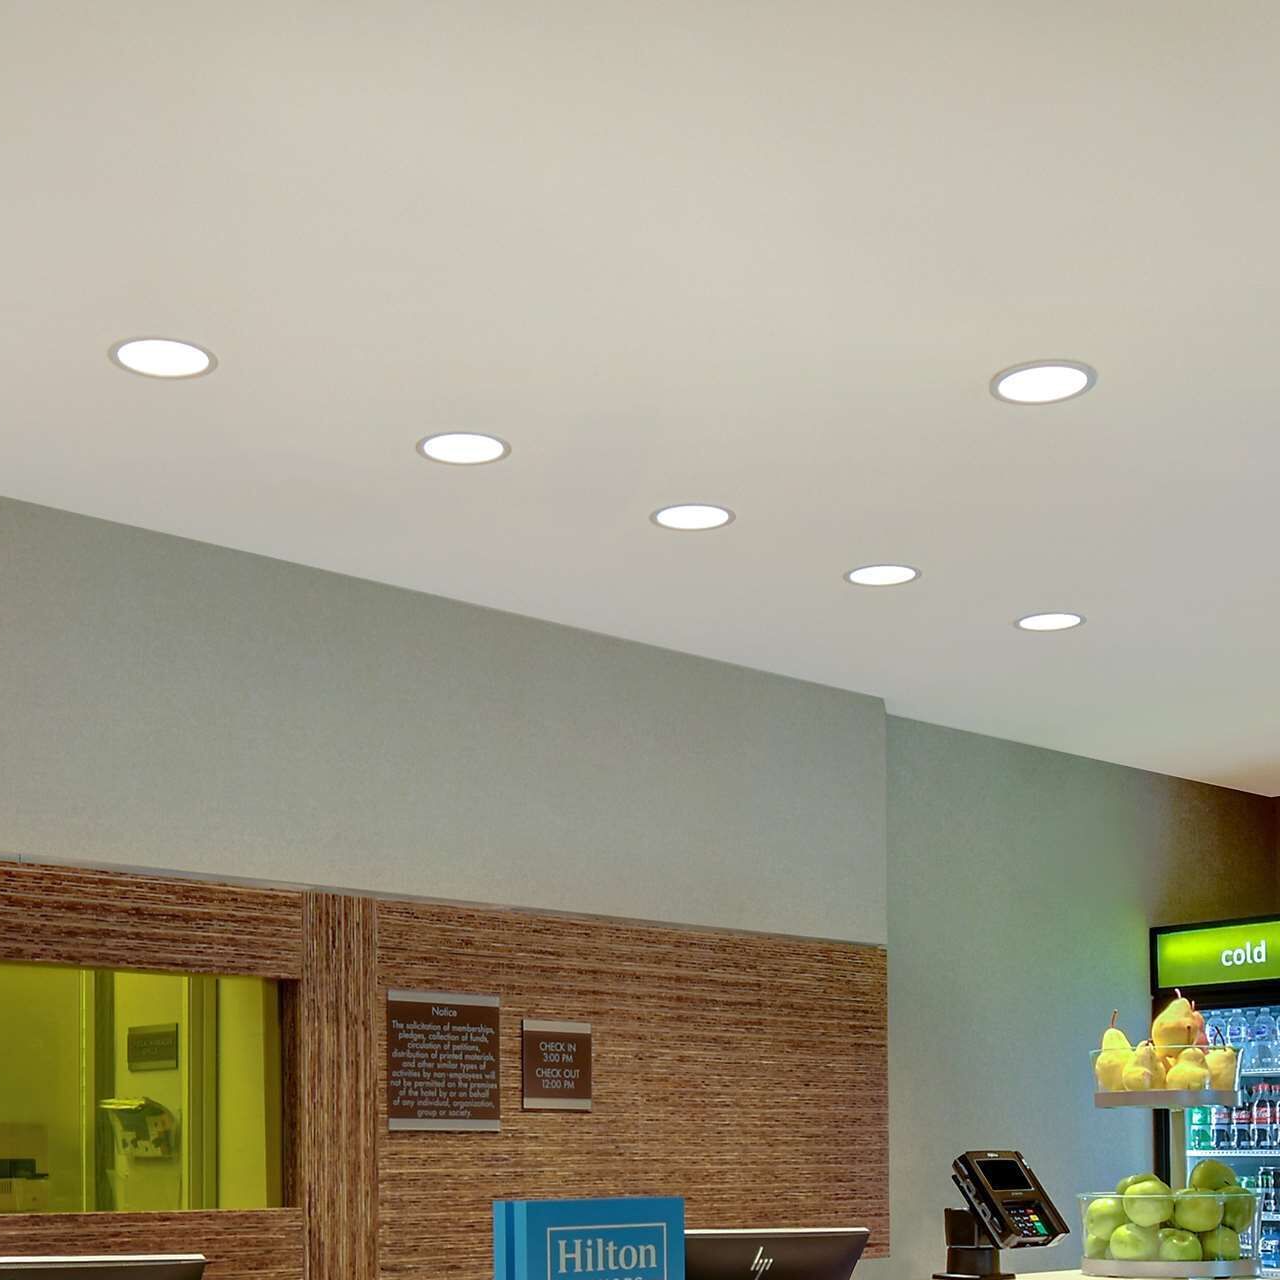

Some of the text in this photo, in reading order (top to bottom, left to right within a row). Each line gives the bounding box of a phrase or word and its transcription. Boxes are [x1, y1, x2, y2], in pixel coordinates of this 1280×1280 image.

[1220, 940, 1267, 967] cold
[431, 1006, 458, 1017] Notice
[539, 1041, 577, 1053] CHECK IN
[543, 1052, 574, 1063] 3:00 PM
[536, 1067, 580, 1079] CHECK OUT
[563, 1079, 575, 1089] PM
[557, 1237, 658, 1275] Hilton
